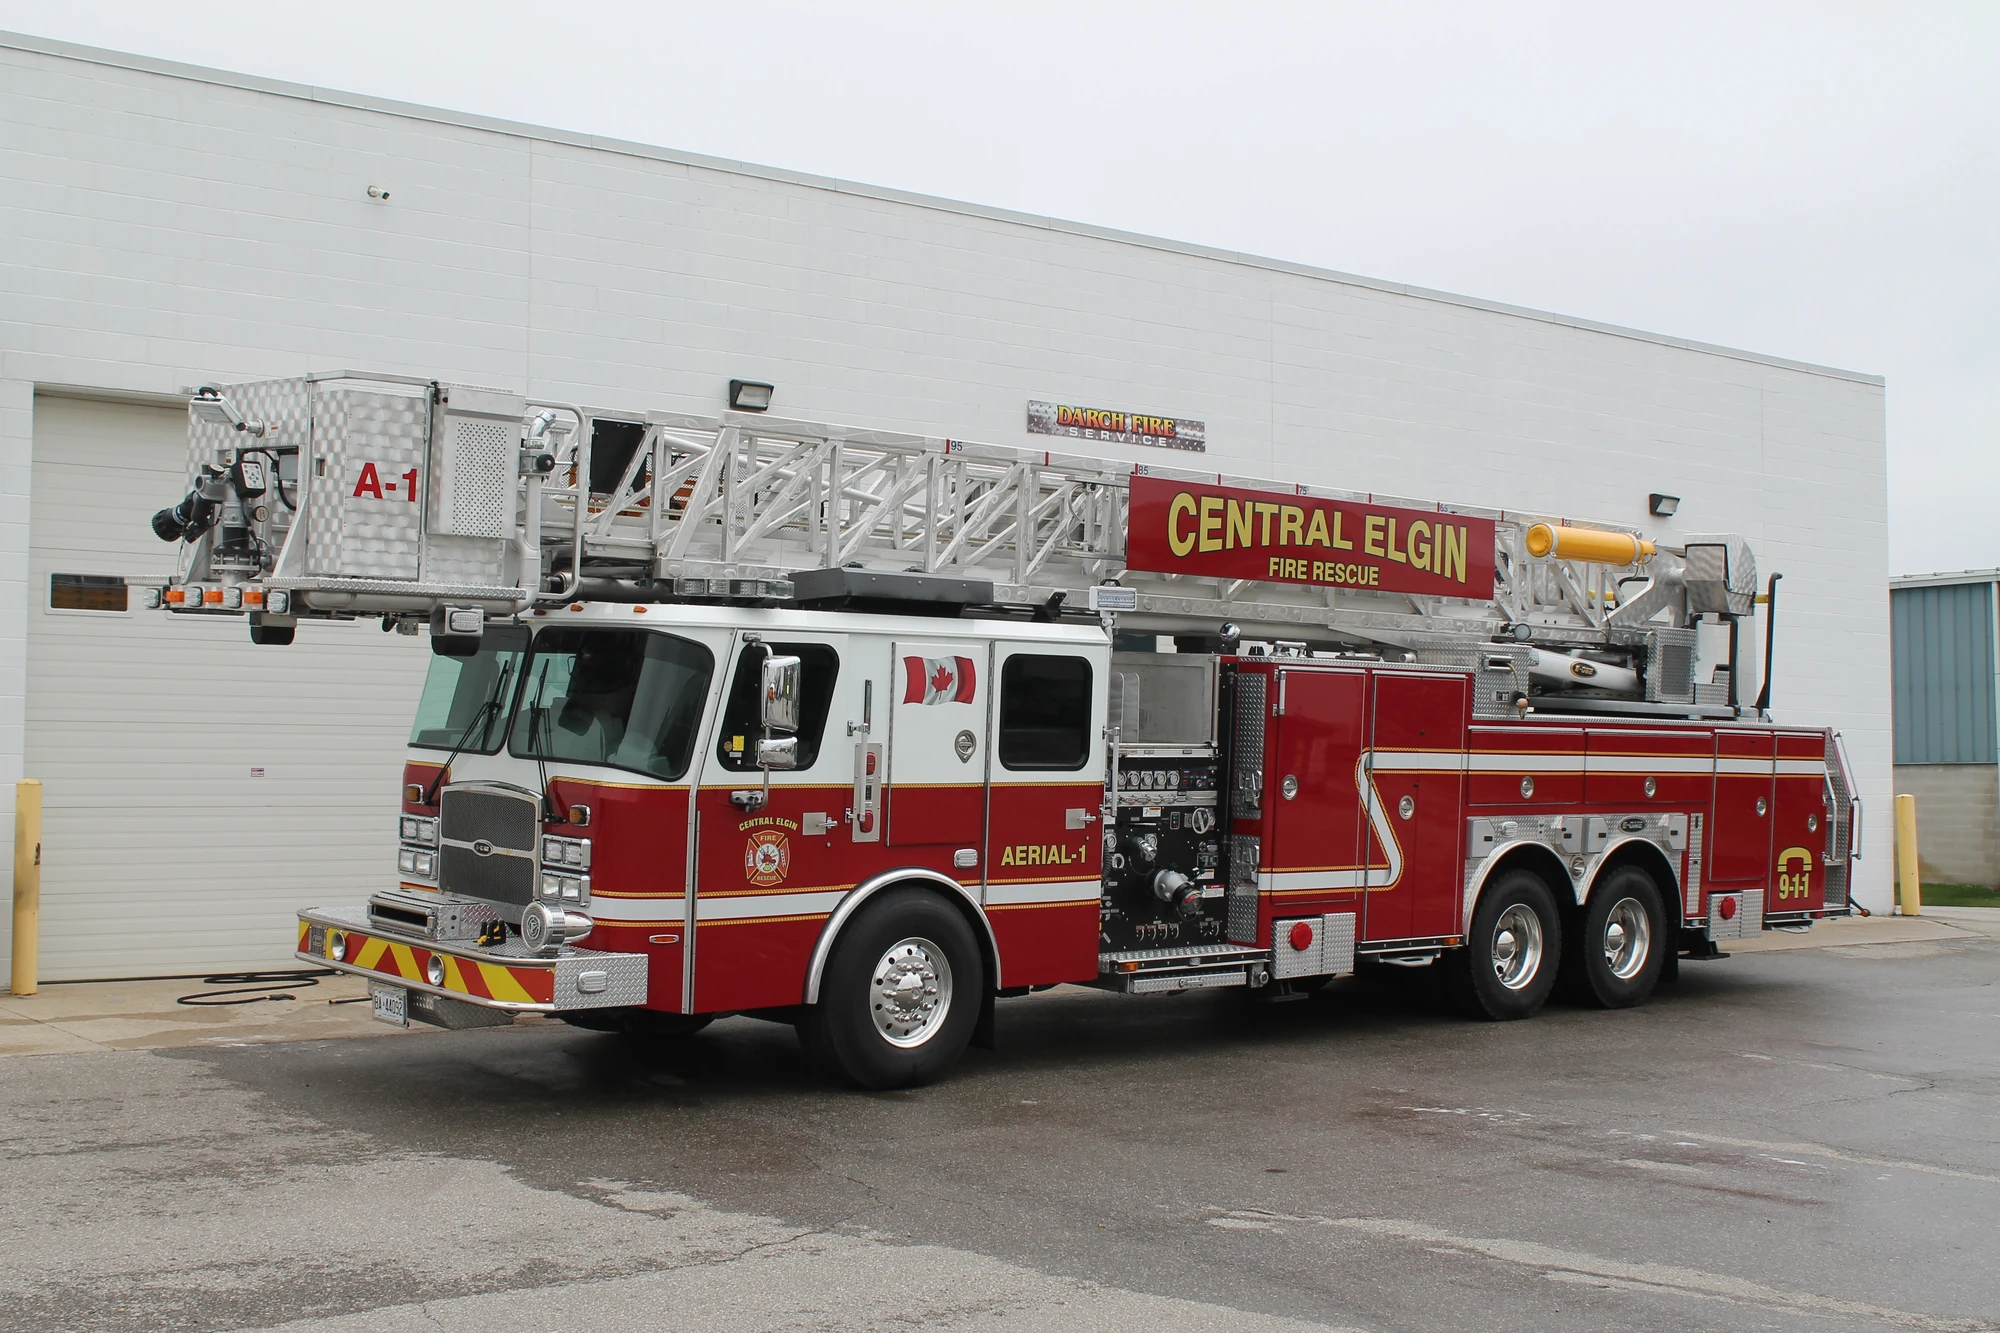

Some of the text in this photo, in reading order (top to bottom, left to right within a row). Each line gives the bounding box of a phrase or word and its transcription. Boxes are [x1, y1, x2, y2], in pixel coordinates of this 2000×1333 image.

[1057, 405, 1176, 437] DARCH FIRE
[951, 440, 963, 451] 95
[1068, 426, 1168, 447] SERVICE
[352, 462, 418, 502] A-1
[1138, 465, 1149, 475] 85
[1167, 492, 1467, 584] CENTRAL ELGIN
[1268, 556, 1380, 586] FIRE RESCUE
[738, 816, 798, 832] CENTRAL ELGIN
[1000, 844, 1086, 867] AERIAL-1
[1778, 872, 1809, 900] 9-1-1
